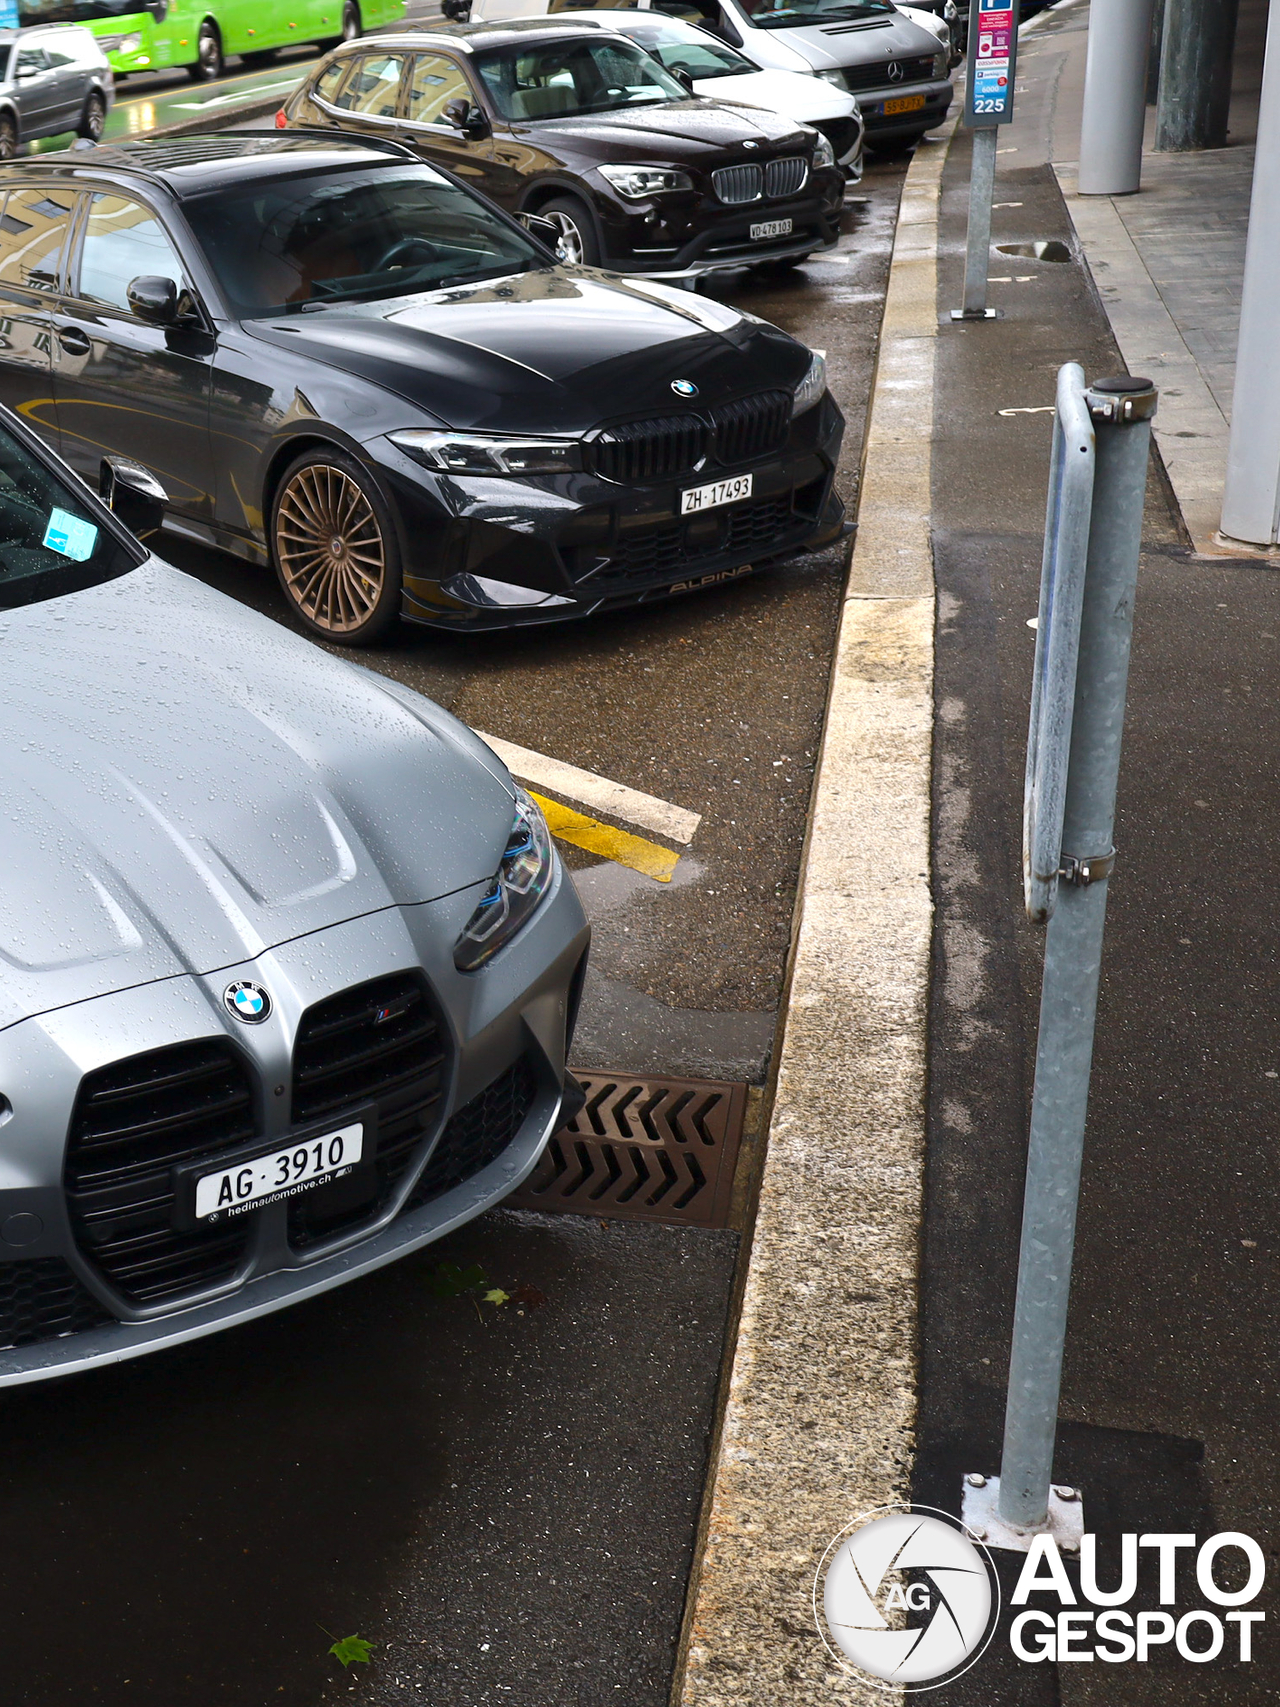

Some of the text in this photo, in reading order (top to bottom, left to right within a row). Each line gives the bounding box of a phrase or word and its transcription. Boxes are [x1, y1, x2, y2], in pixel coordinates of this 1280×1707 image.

[974, 98, 1005, 113] 225
[669, 564, 753, 593] ALPINA
[227, 1173, 332, 1217] hedinautomotive.ch
